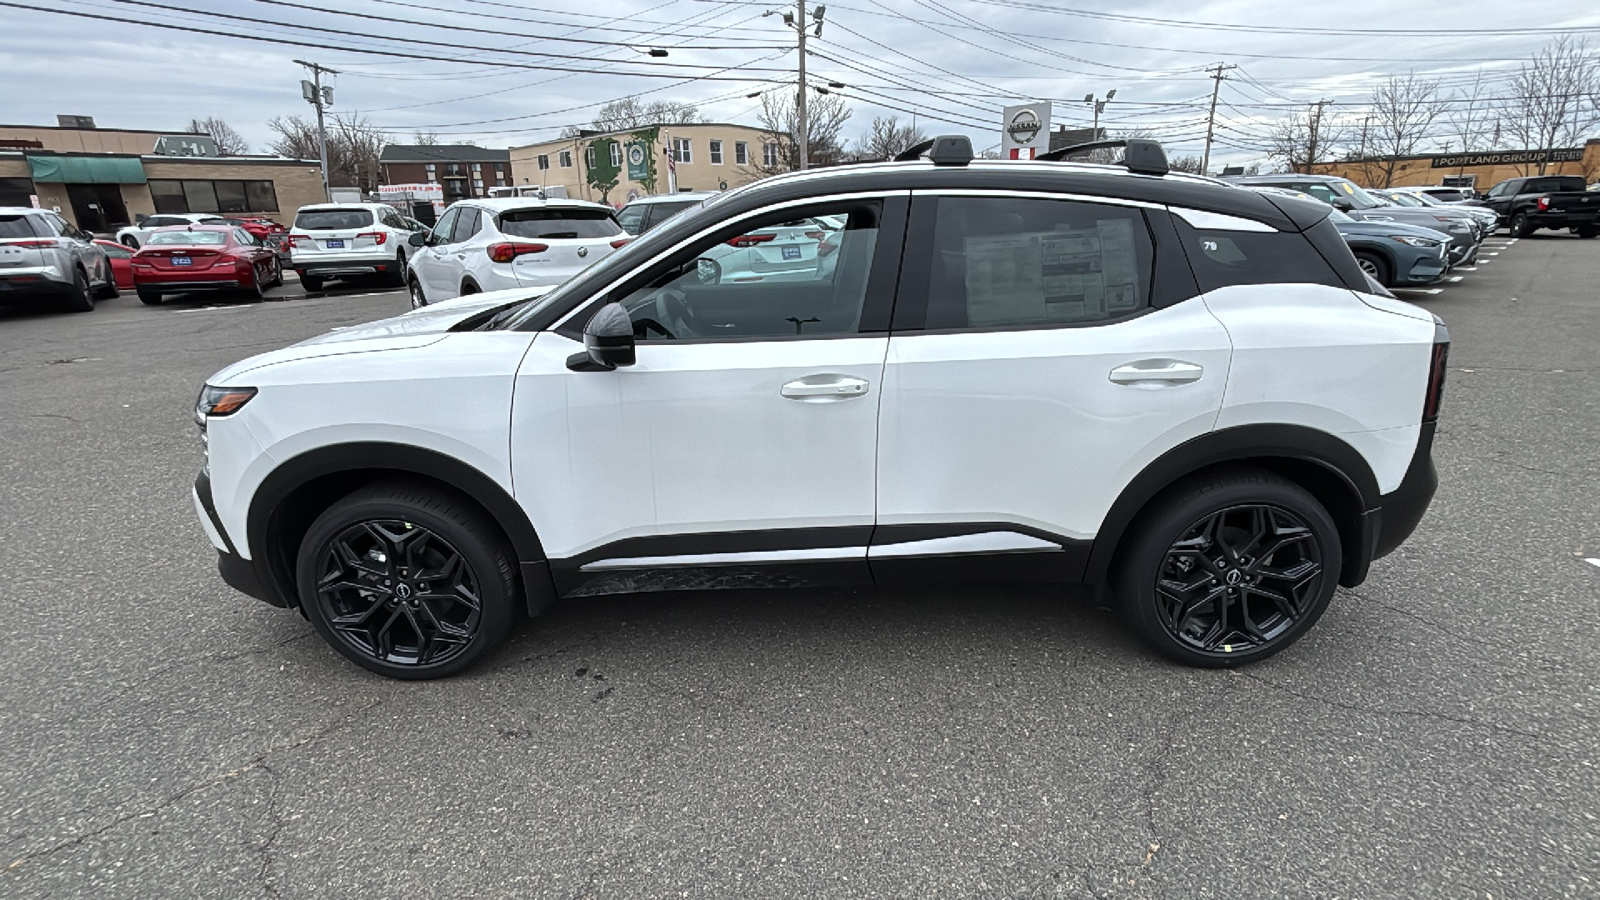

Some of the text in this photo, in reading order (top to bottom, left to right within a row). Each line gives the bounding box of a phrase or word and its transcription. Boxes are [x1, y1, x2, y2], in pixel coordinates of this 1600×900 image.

[1010, 121, 1038, 130] NISSAN
[1439, 154, 1500, 166] PORTLAND
[1502, 153, 1546, 162] GROUP
